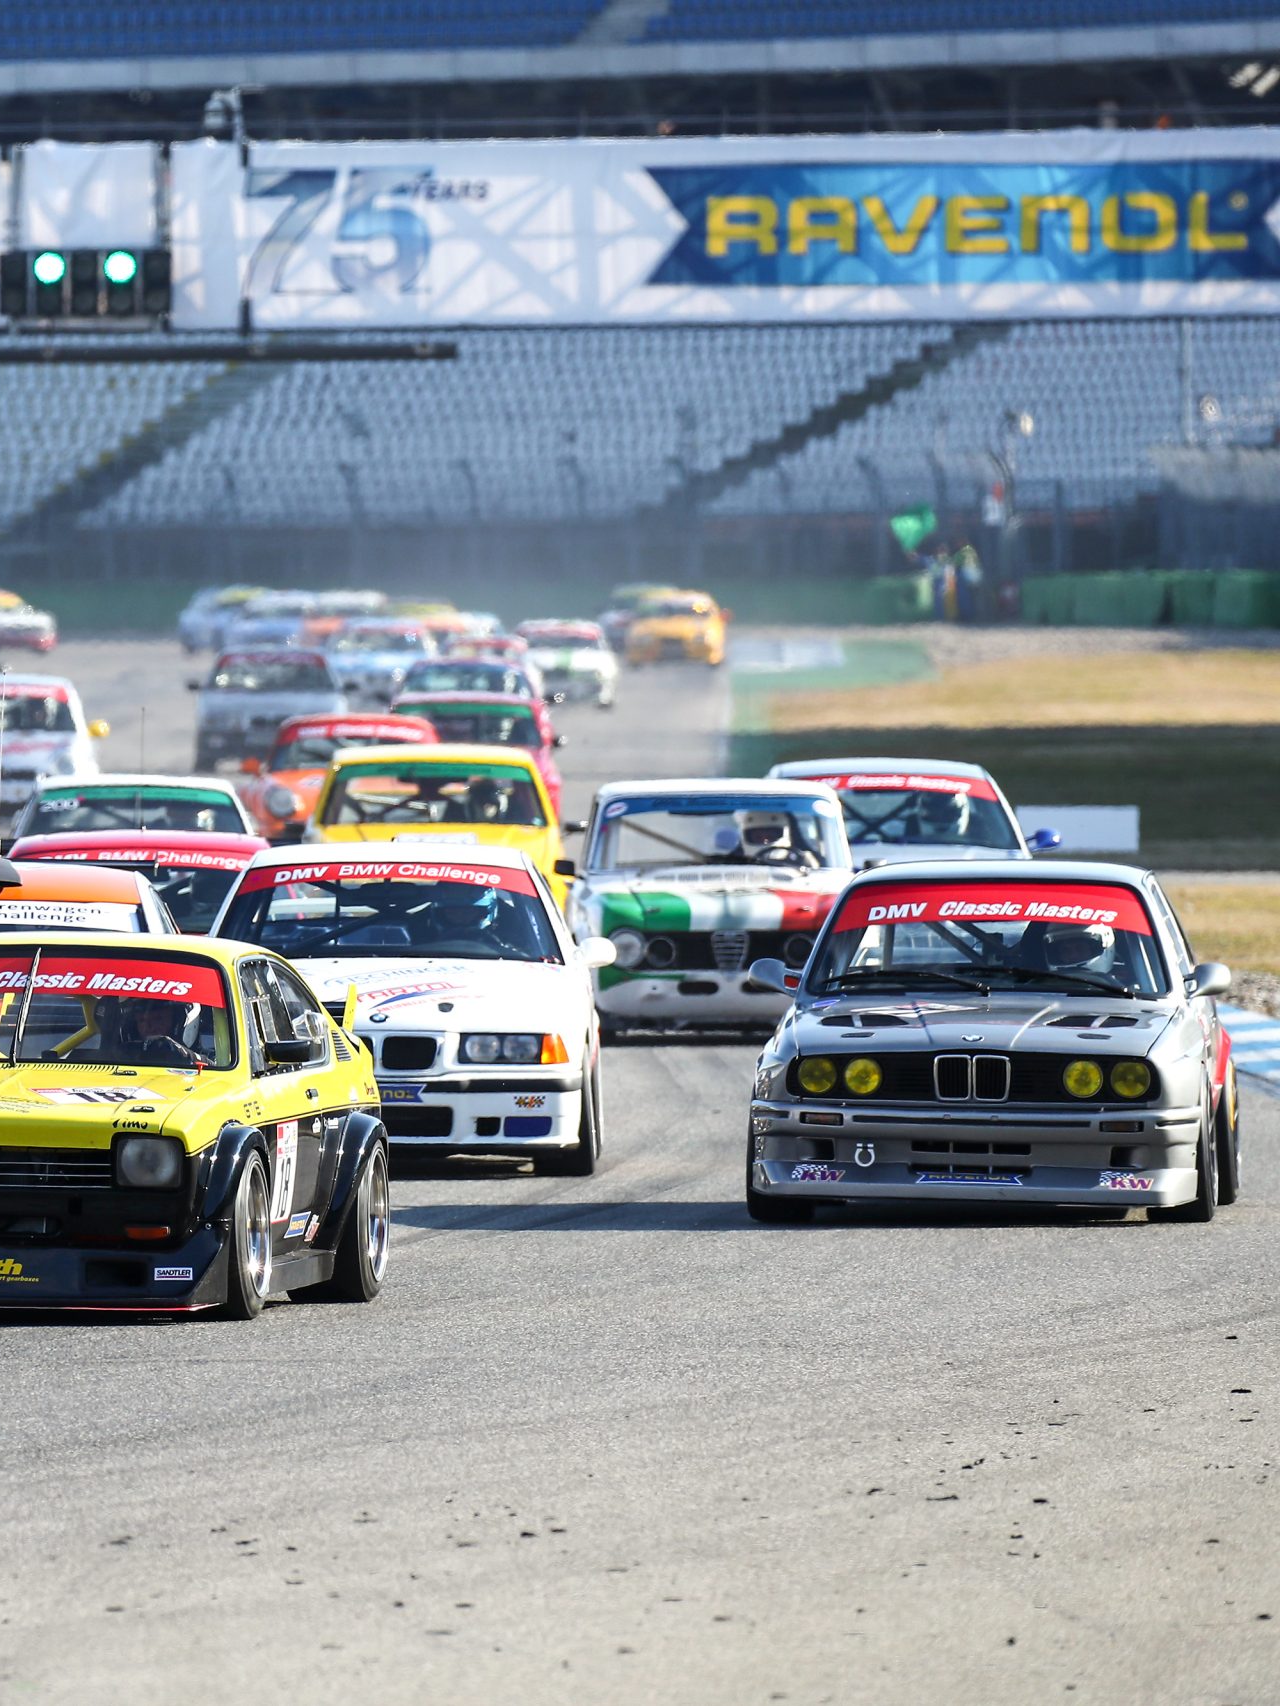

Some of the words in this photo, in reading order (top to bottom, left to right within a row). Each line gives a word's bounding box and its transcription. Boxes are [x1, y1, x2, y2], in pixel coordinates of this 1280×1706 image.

[705, 191, 1248, 256] RAVENOL
[273, 866, 329, 883] DMV
[338, 864, 395, 876] BMW
[397, 864, 502, 885] Challenge
[867, 902, 928, 921] DMV
[938, 901, 1022, 916] Classic
[1023, 902, 1119, 923] Masters
[86, 973, 194, 996] Masters
